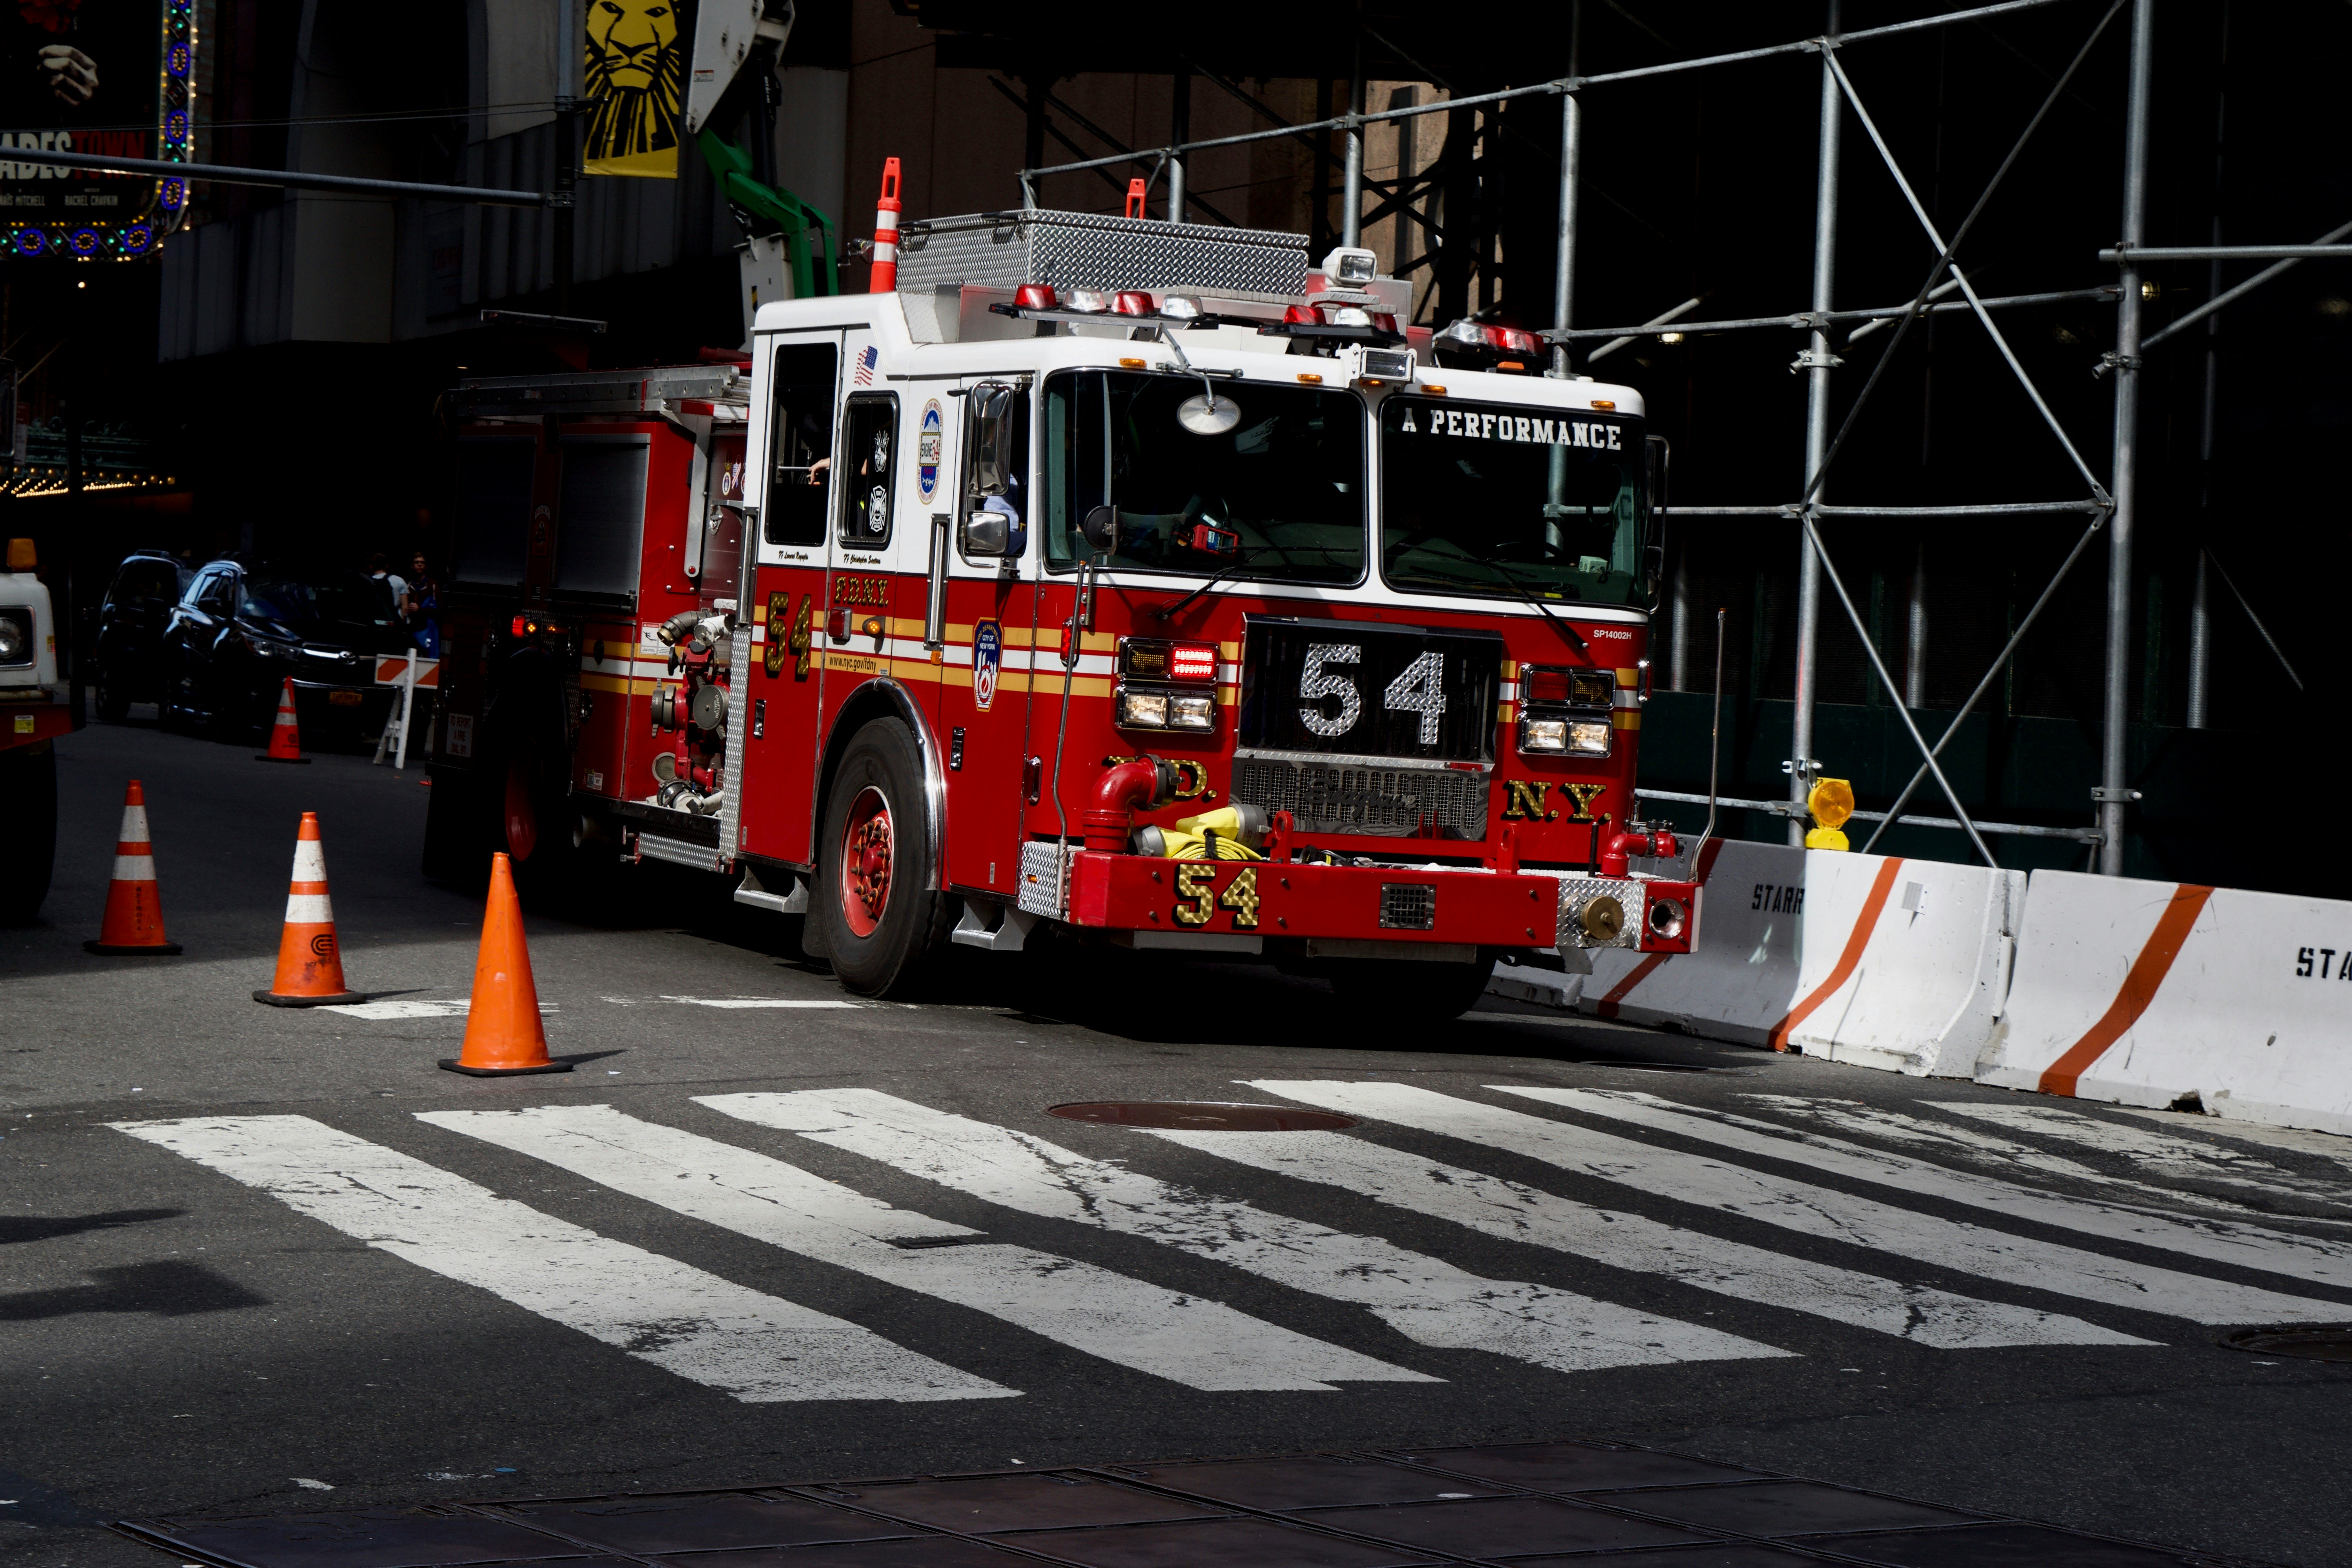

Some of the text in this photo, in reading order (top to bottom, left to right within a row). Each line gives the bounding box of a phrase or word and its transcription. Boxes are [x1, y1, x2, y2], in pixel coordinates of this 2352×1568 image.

[932, 439, 939, 461] 54
[1402, 407, 1621, 451] A PERFORMANCE
[766, 593, 811, 679] 54
[1593, 629, 1632, 641] SP14002H
[829, 656, 877, 674] www.nyc.gov/fdny
[1299, 642, 1447, 745] 54
[1174, 864, 1260, 928] 54
